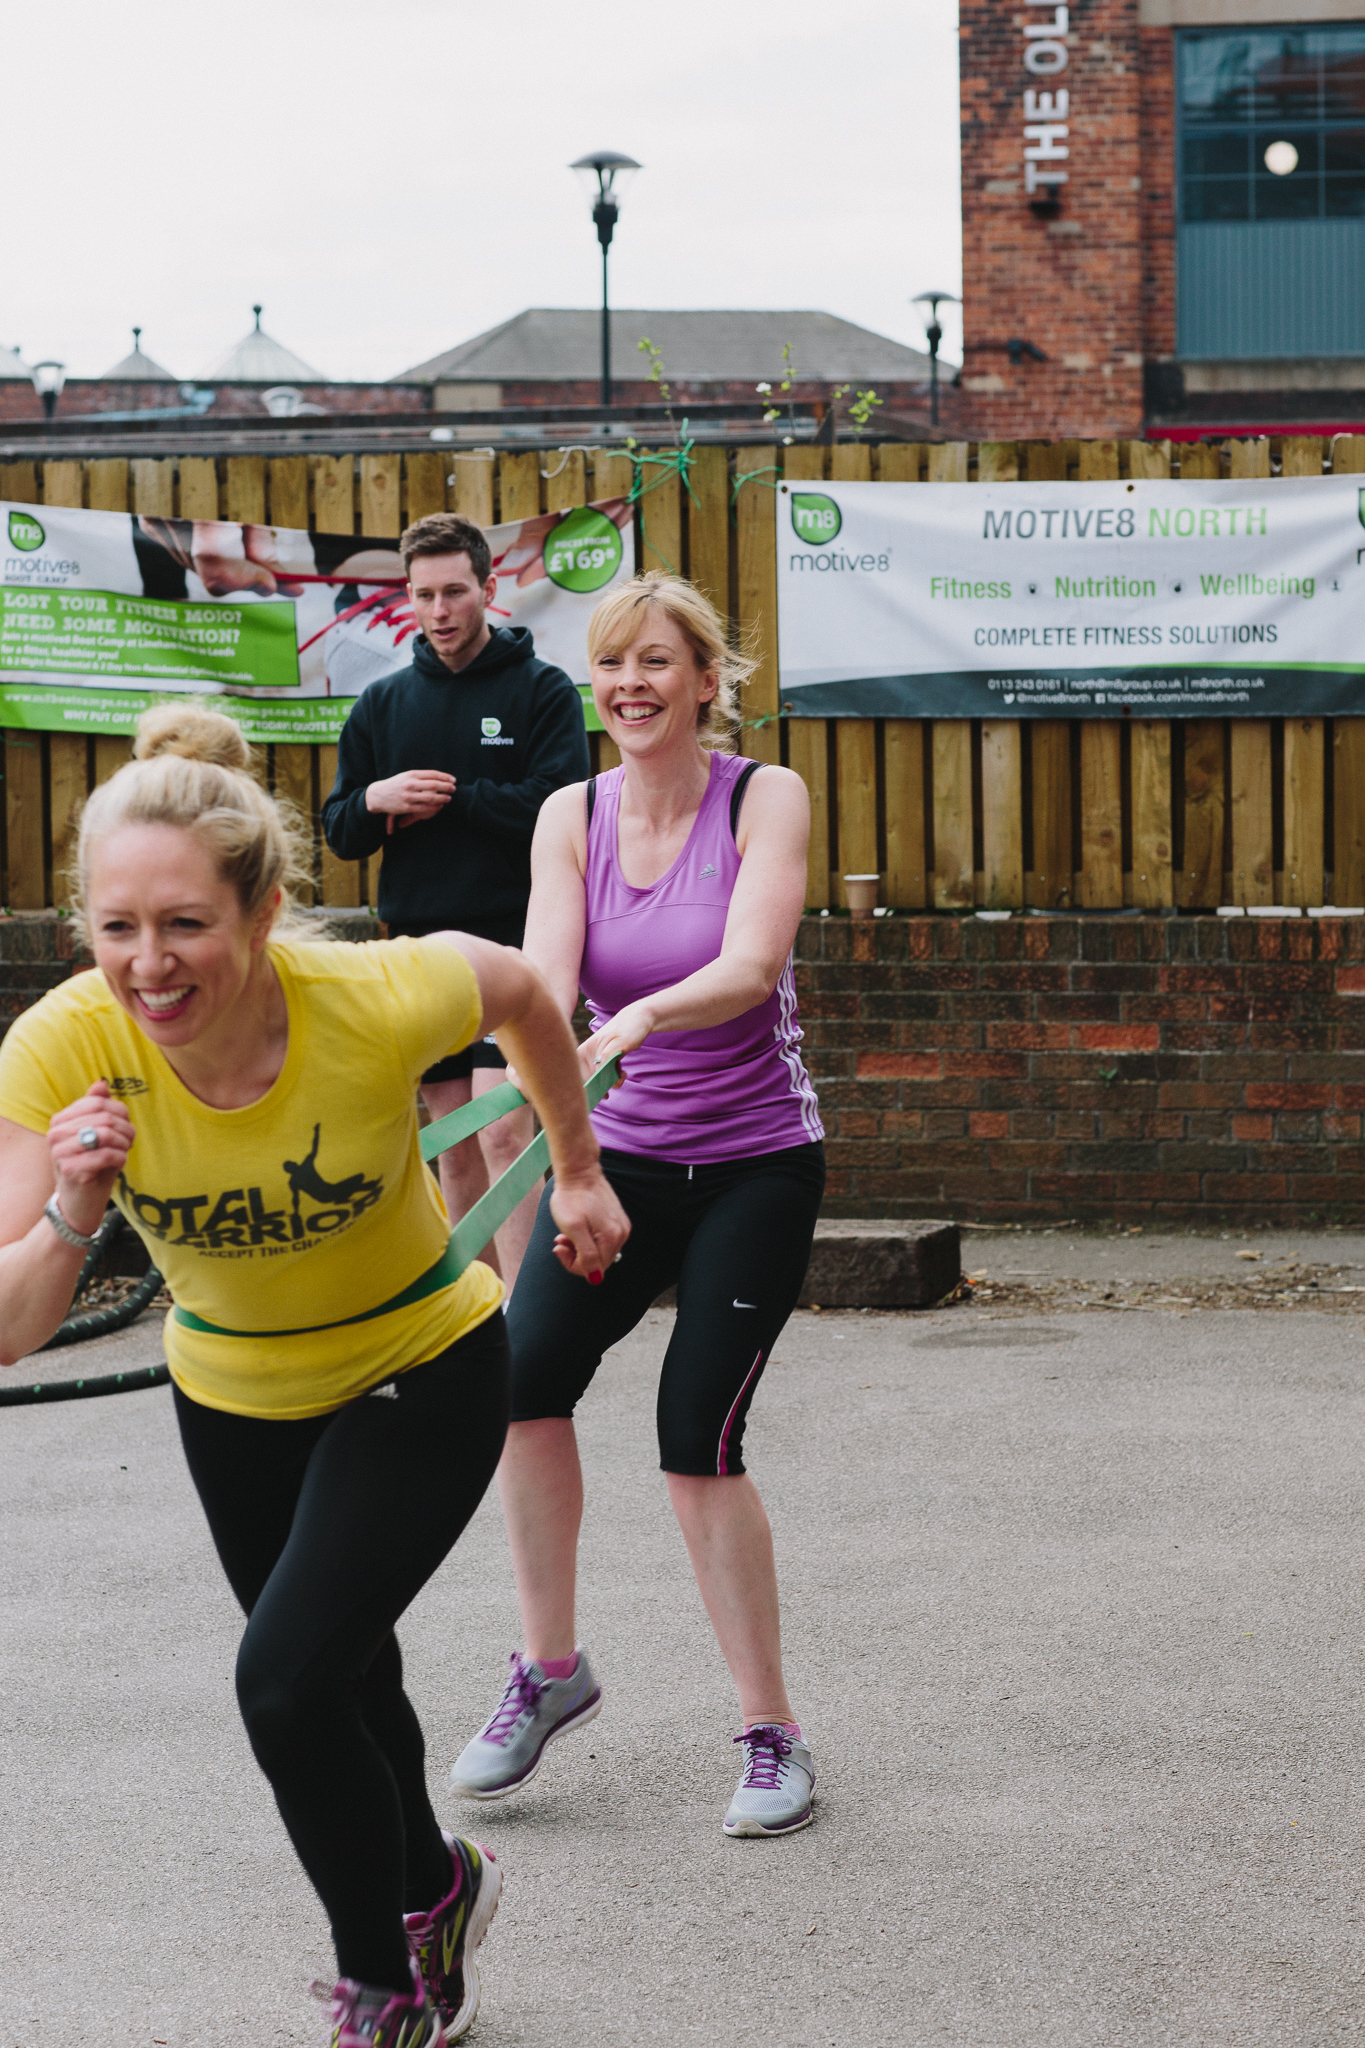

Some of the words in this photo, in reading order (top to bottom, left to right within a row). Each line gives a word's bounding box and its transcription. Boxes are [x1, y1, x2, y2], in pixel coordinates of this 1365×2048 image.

[1023, 0, 1070, 75] OL
[1023, 88, 1070, 195] THE
[797, 508, 836, 529] m8
[983, 508, 1135, 538] MOTIVE8
[1149, 508, 1266, 537] NORTH
[5, 553, 80, 576] motive8
[790, 547, 890, 572] motive8
[931, 576, 1012, 599] Fitness
[1055, 575, 1156, 598] Nutrition
[1200, 573, 1315, 599] Wellbeing
[4, 593, 51, 610] LOST
[58, 595, 109, 613] YOUR
[115, 600, 178, 622] FITNESS
[184, 609, 242, 623] MOJO?
[4, 613, 56, 631] NEED
[63, 616, 117, 633] SOME
[124, 619, 240, 643] MOTIVATION?
[974, 626, 1077, 646] COMPLETE
[1084, 626, 1162, 645] FITNESS
[1169, 624, 1278, 644] SOLUTIONS
[97, 635, 125, 649] Camp
[988, 678, 1013, 690] 0113
[1014, 679, 1034, 690] 243
